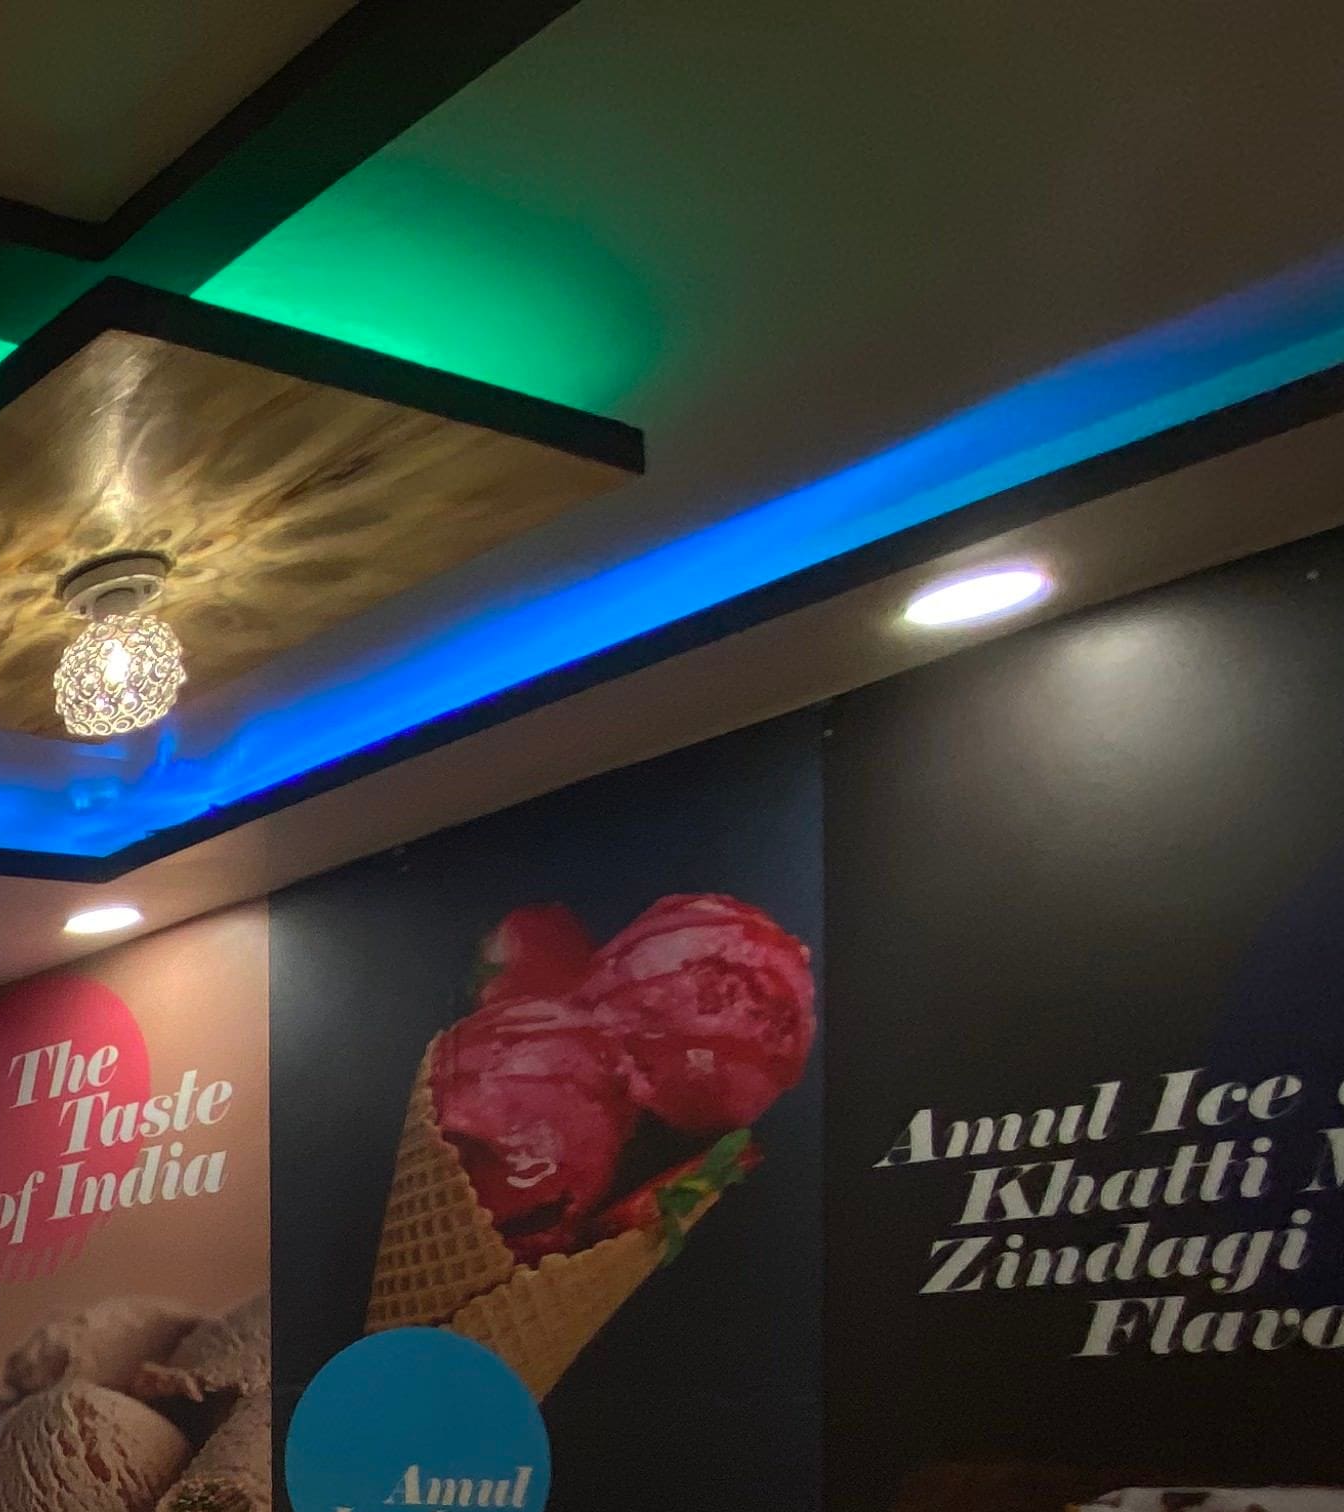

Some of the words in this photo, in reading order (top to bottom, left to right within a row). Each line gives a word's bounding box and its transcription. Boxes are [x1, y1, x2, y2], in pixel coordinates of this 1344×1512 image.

[7, 1040, 119, 1109] The
[58, 1068, 233, 1157] Taste
[871, 1080, 1121, 1168] Amul
[1135, 1067, 1303, 1135] Ice
[45, 1141, 228, 1221] India
[950, 1136, 1273, 1227] Khatti
[917, 1209, 1313, 1295] Zindagi
[383, 1464, 534, 1507] Amul
